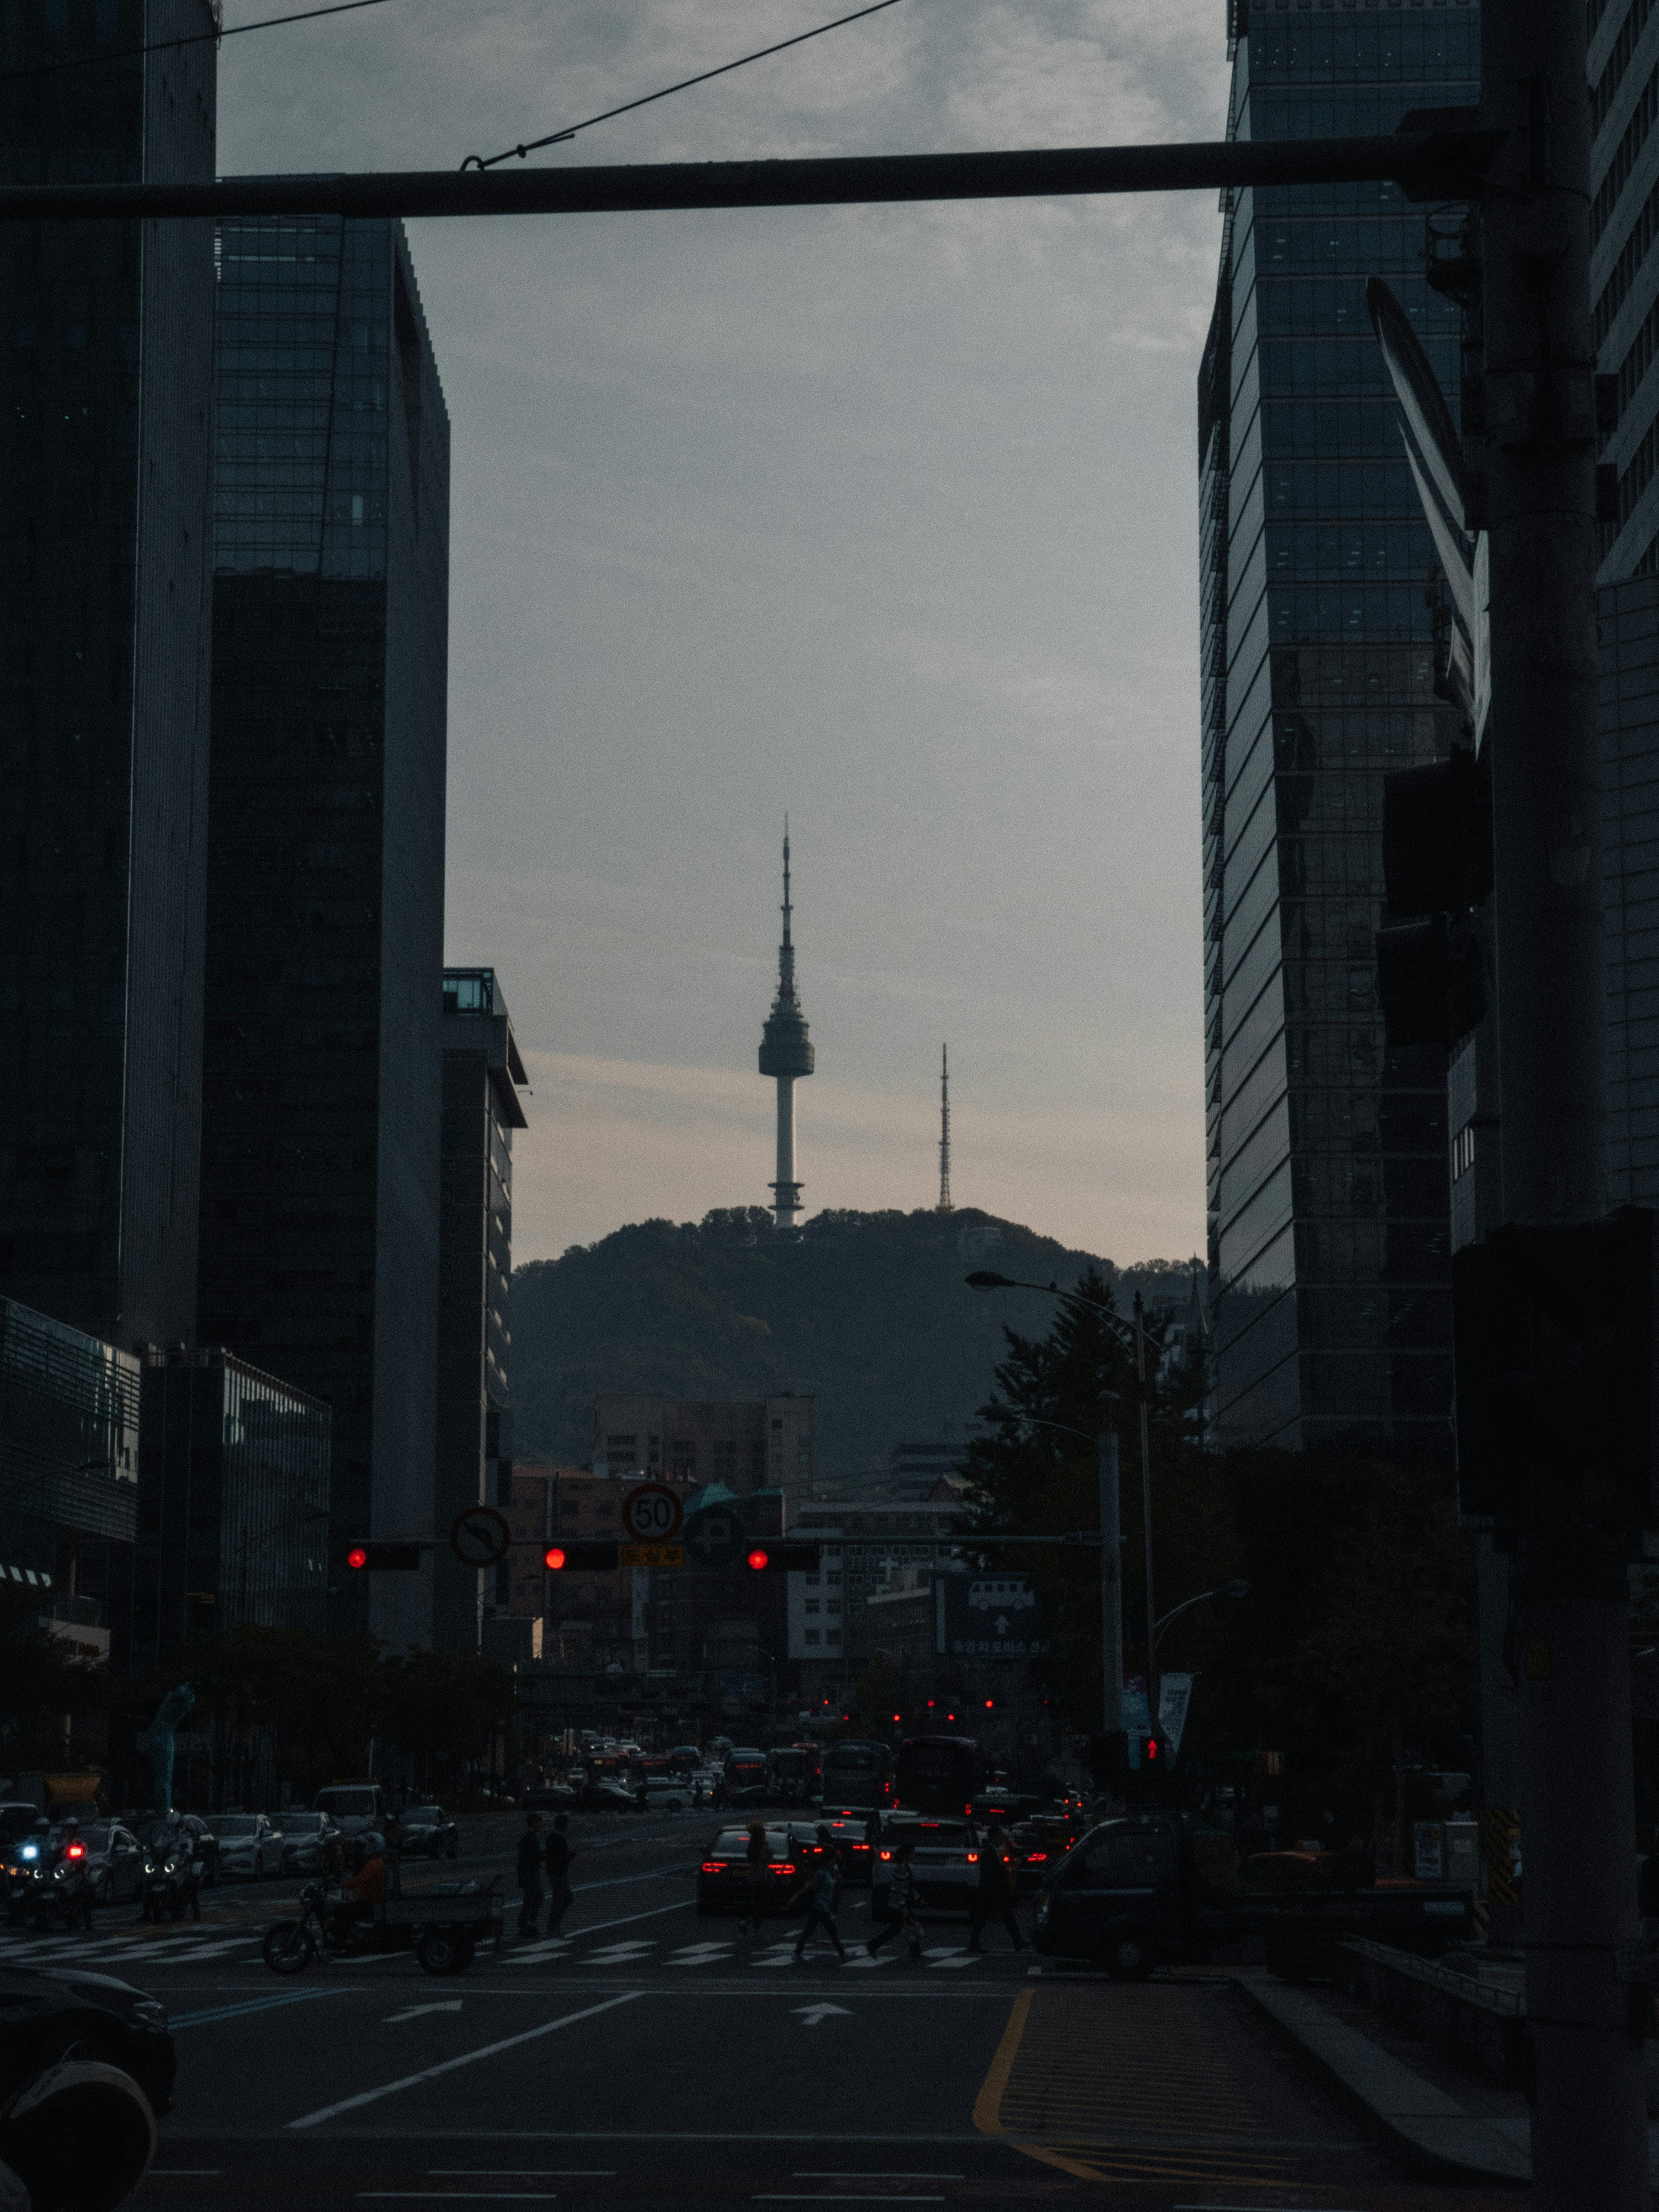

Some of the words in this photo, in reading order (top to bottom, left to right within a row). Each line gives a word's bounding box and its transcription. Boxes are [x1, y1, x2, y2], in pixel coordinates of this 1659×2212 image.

[636, 1499, 670, 1529] 50
[626, 1549, 679, 1563] 도심부
[953, 1640, 1025, 1653] 중앙차로버스
